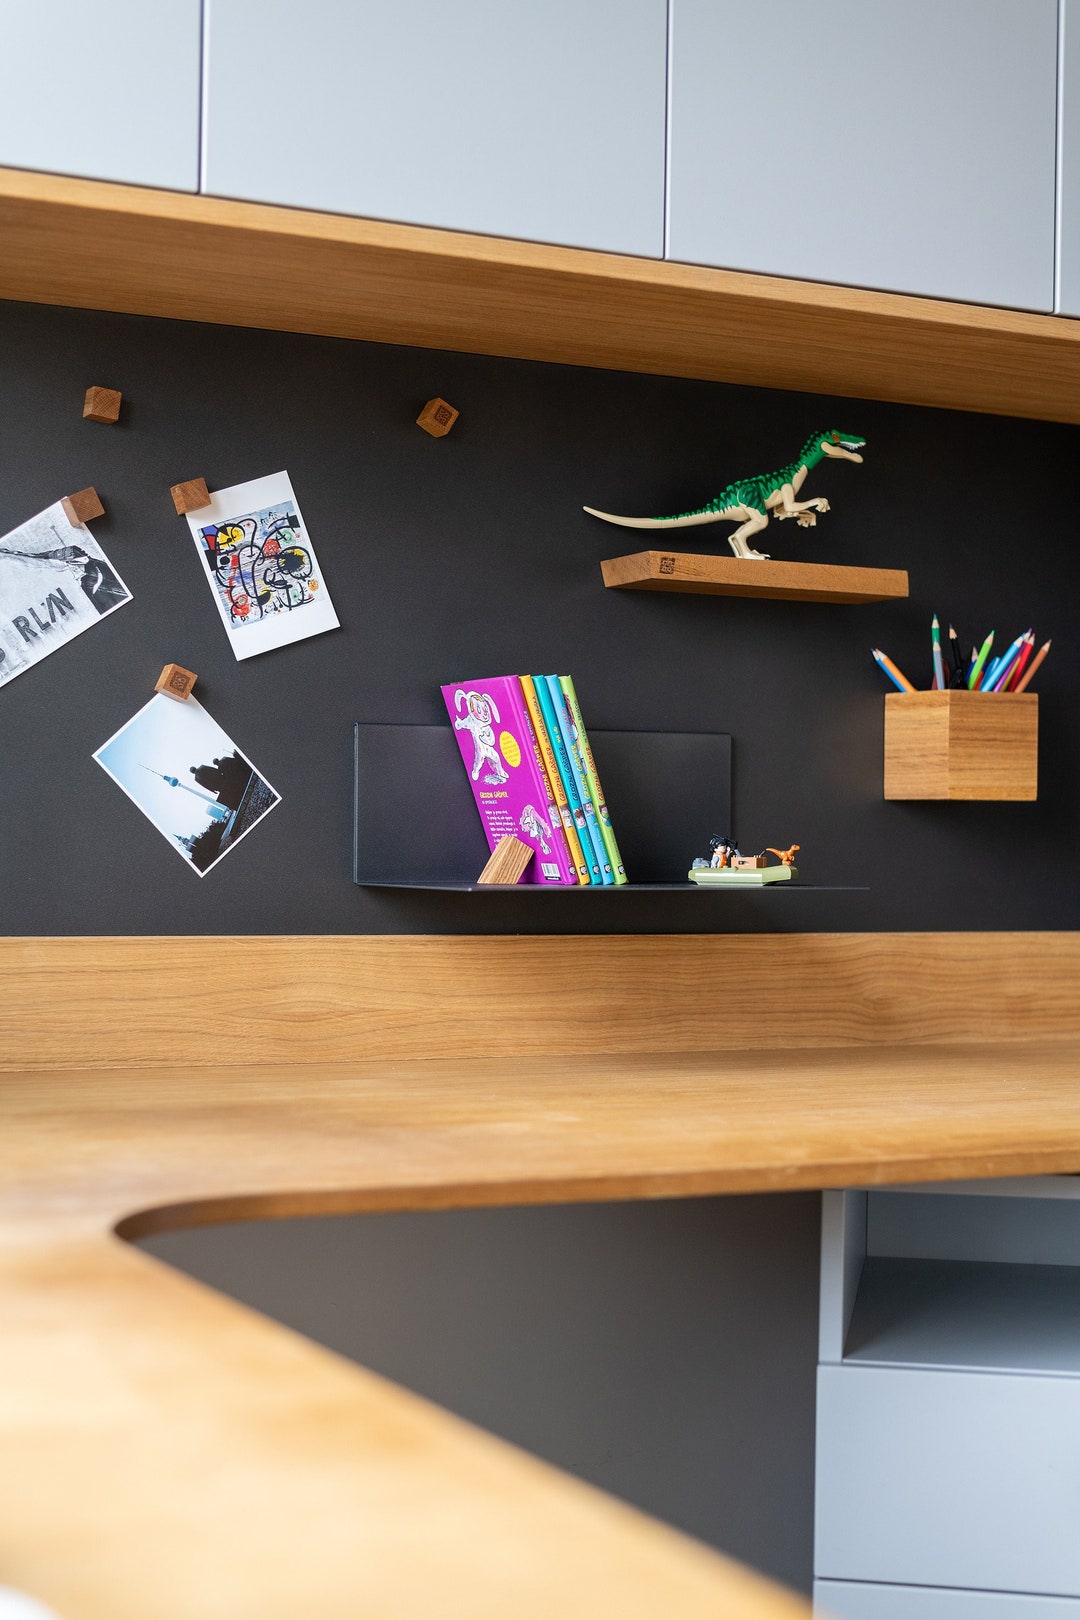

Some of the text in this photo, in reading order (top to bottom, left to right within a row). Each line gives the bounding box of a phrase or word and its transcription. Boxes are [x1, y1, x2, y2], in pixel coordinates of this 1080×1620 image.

[542, 774, 553, 800] GROZNI
[554, 775, 566, 801] GROZNI
[567, 775, 578, 800] GROZNI
[580, 773, 590, 798] GROZNI
[594, 775, 603, 800] GROZNI
